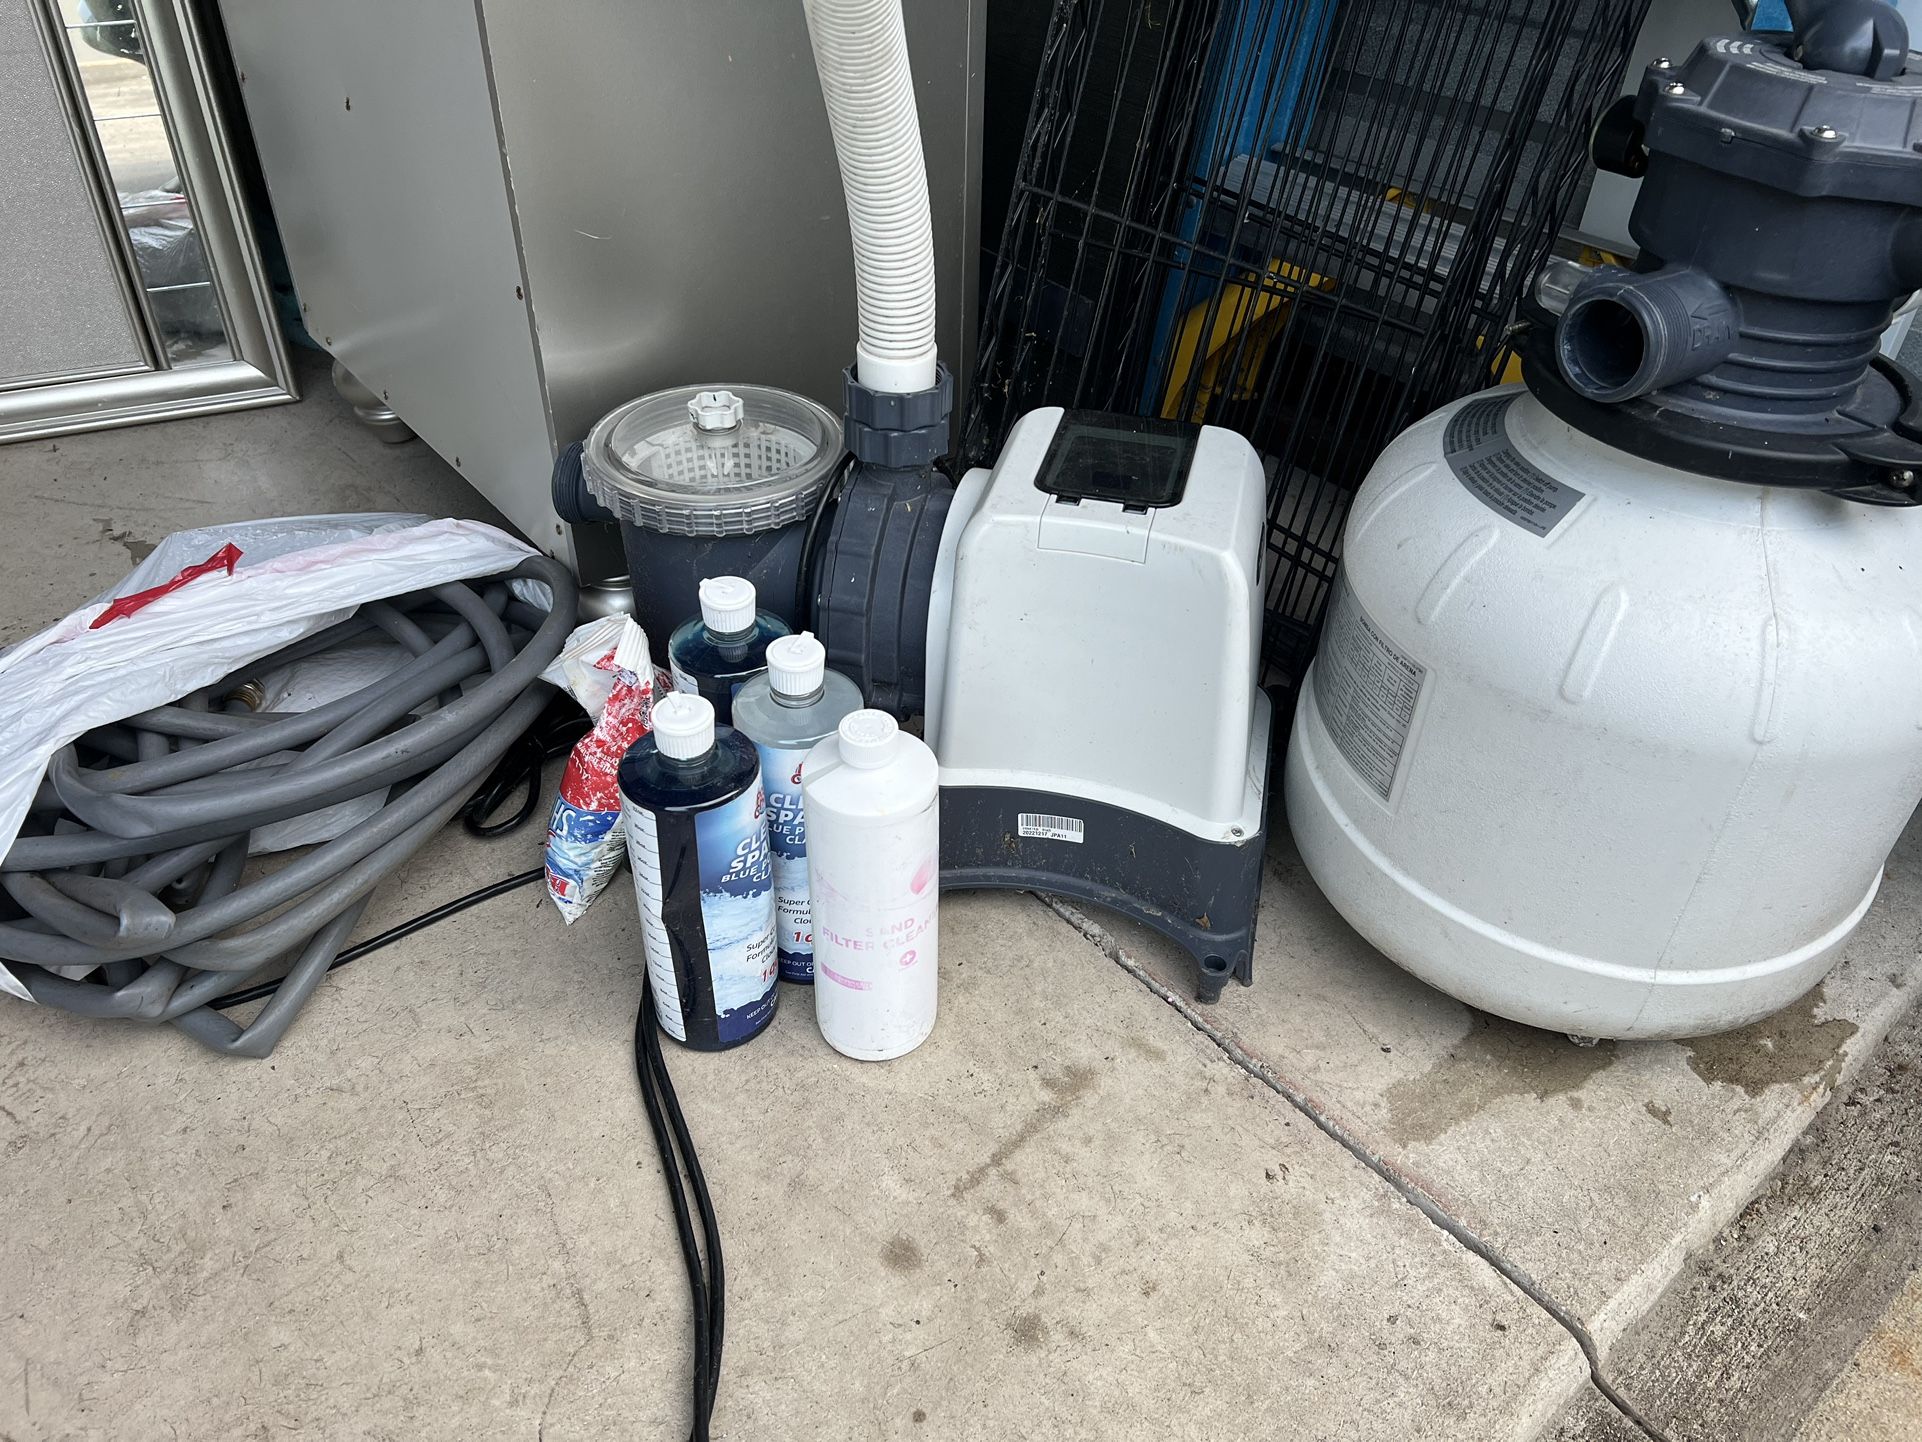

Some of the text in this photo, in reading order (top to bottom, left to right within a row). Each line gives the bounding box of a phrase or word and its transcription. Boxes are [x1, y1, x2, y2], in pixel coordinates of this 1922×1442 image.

[721, 865, 759, 883] BLUE
[777, 896, 806, 907] Super
[794, 931, 802, 943] 1
[746, 1006, 761, 1020] KEEP
